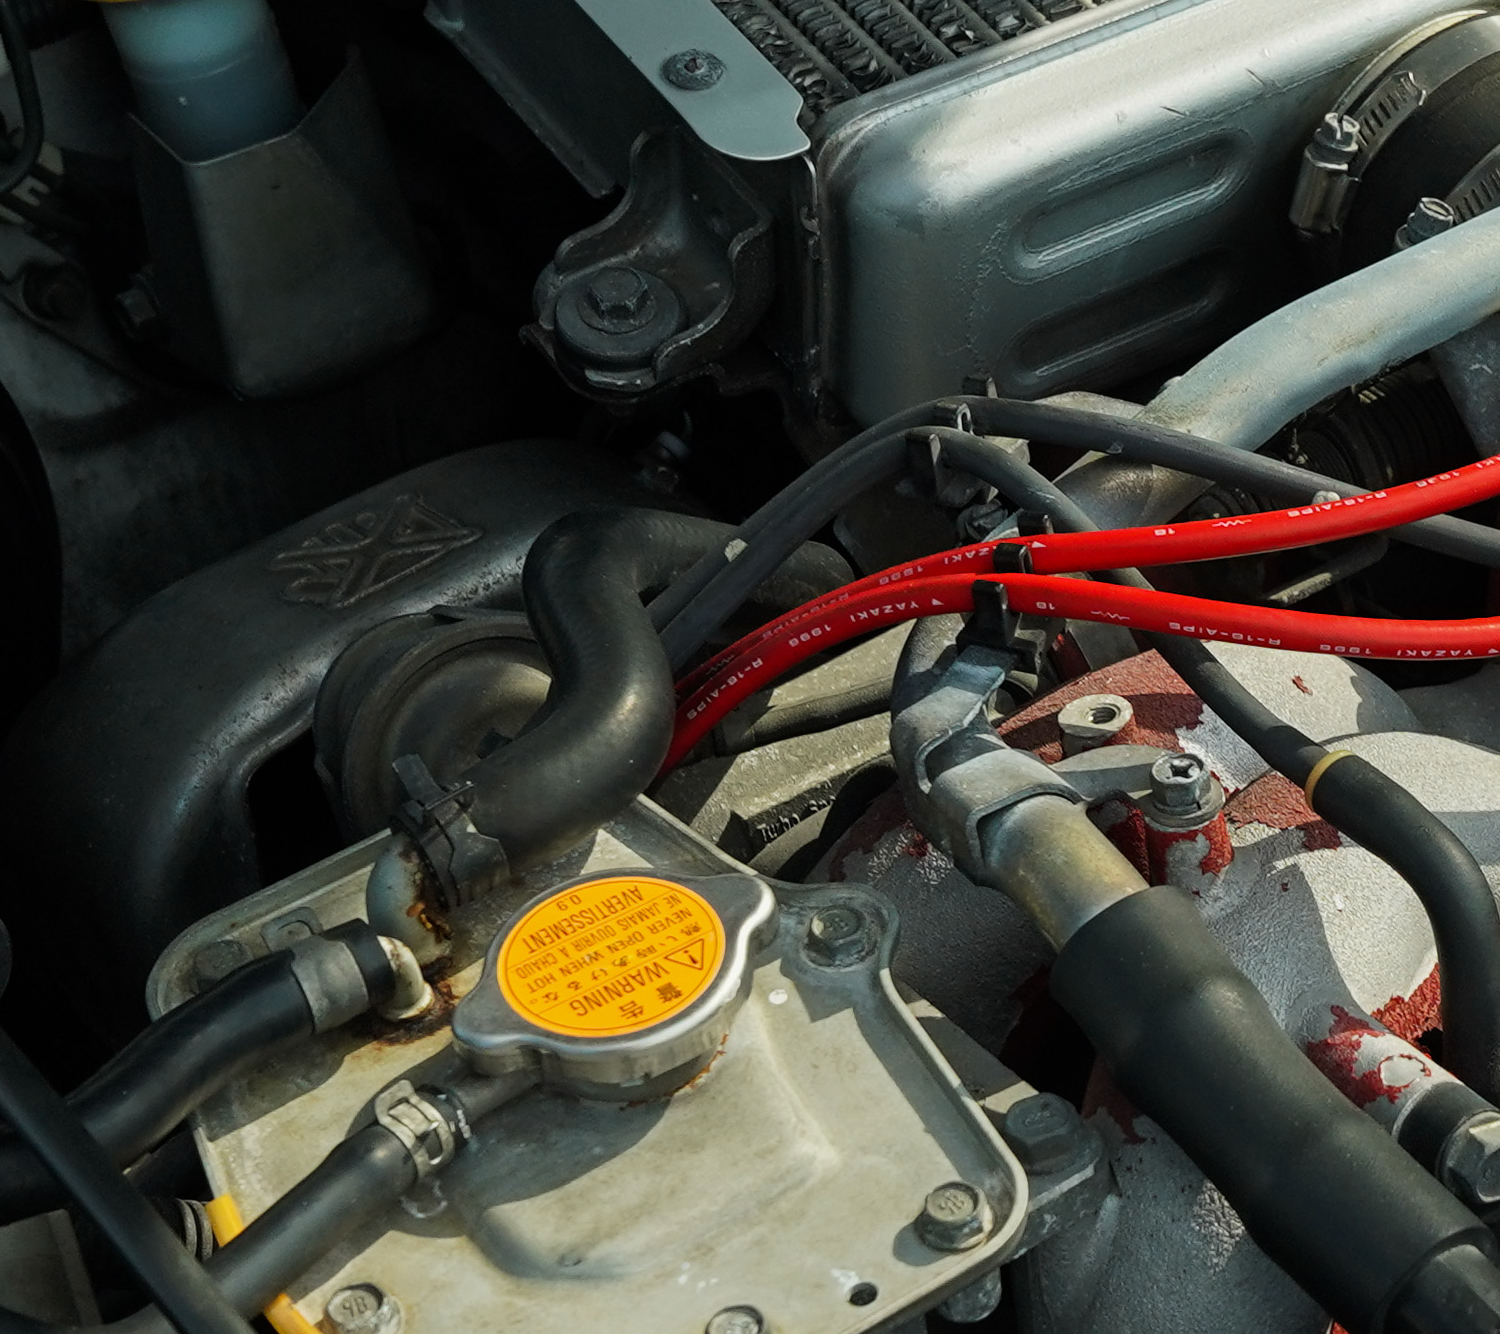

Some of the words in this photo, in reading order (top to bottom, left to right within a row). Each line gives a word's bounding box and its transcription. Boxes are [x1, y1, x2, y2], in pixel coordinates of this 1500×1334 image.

[849, 598, 921, 625] YAZAKI
[1395, 646, 1477, 660] YAZAKI
[555, 892, 581, 912] 0.9
[662, 892, 682, 909] NE
[520, 884, 644, 954] AVERTISSEMENT
[614, 902, 661, 931] JAMAIS
[646, 906, 692, 935] NEVER
[570, 924, 616, 952] OUVRIR
[605, 929, 645, 953] OPEN
[558, 949, 605, 977] WHEN
[525, 972, 557, 994] HOT
[568, 961, 670, 1017] WARNING
